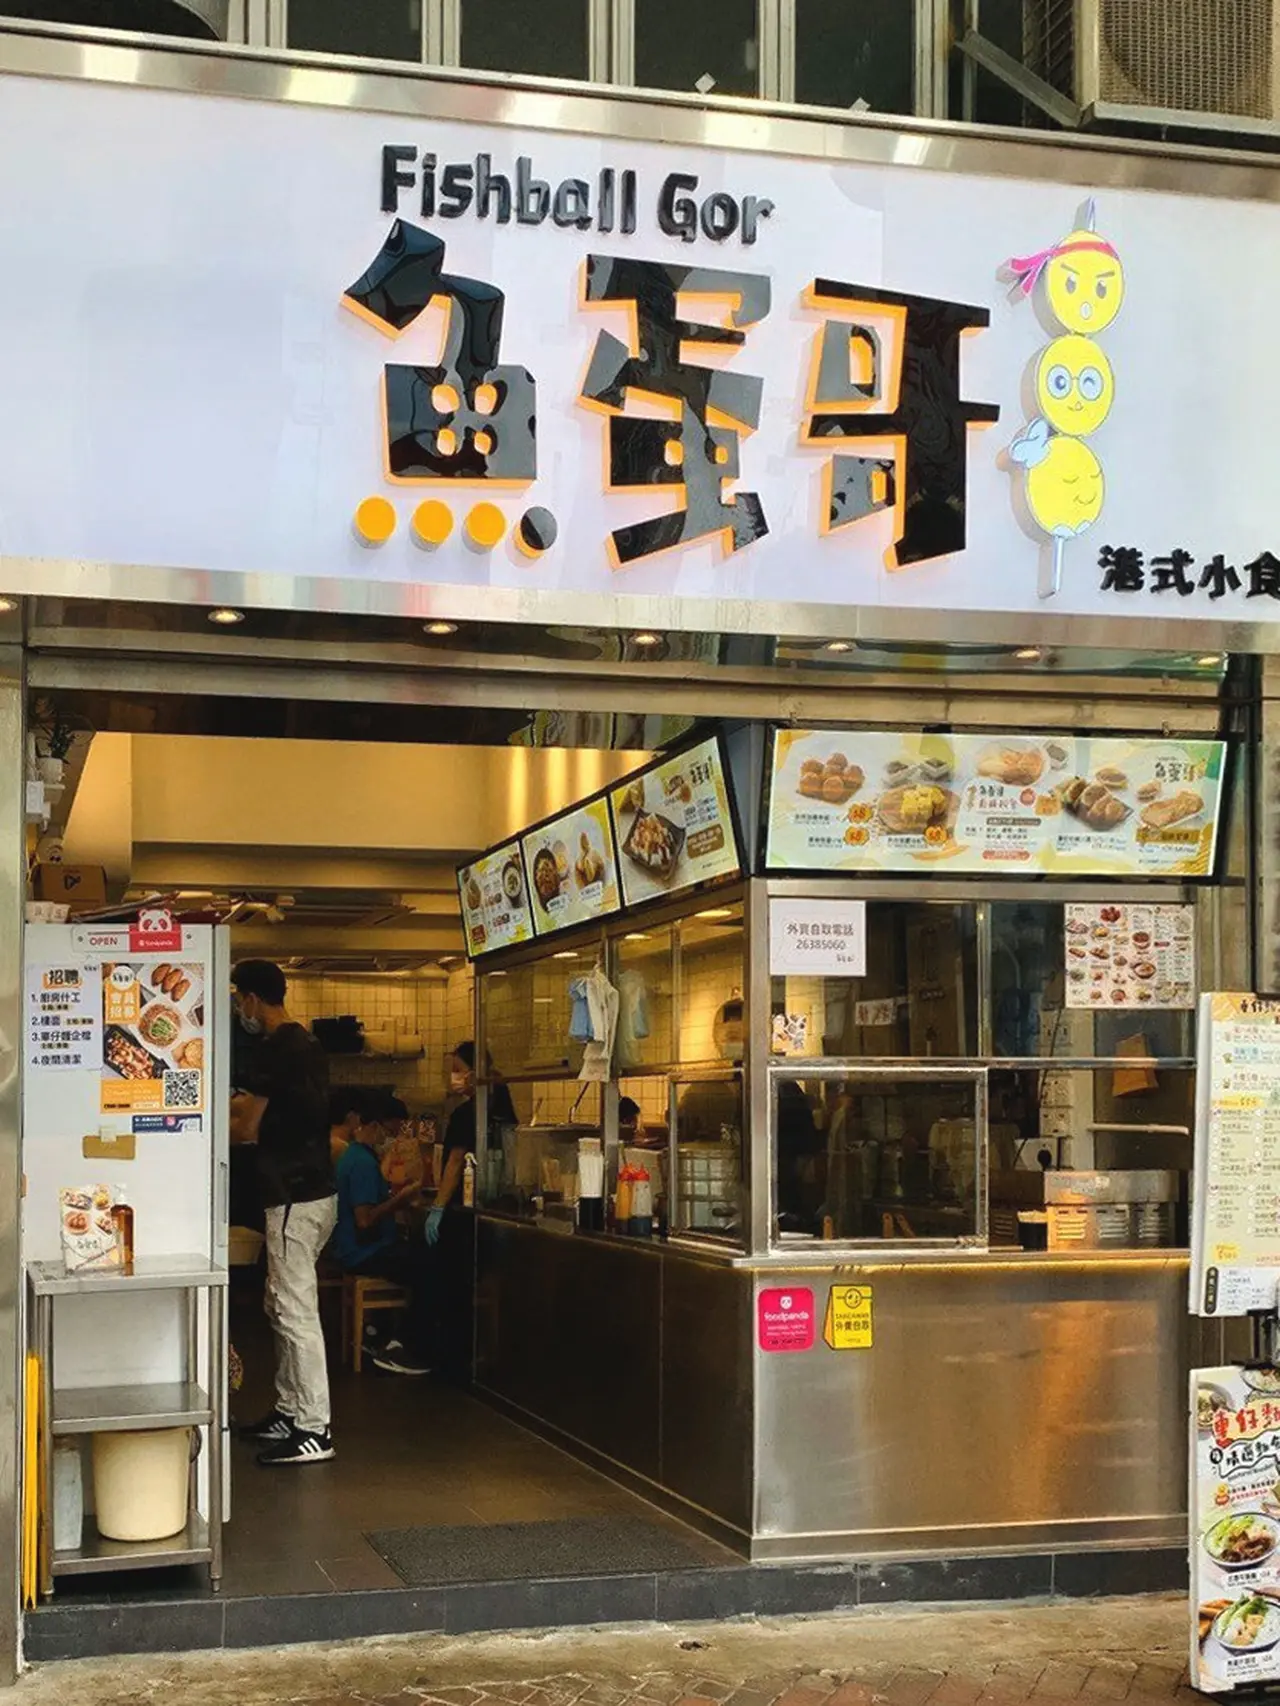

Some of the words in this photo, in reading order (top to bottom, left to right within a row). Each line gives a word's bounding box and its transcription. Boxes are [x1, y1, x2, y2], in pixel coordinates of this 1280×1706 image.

[380, 145, 637, 234] Fishball
[658, 173, 774, 245] Gor
[342, 217, 1000, 570] 魚蛋哥
[1098, 545, 1280, 600] 港式小食
[89, 936, 118, 946] OPEN
[796, 939, 846, 950] 26385060
[49, 968, 79, 985] 招聘
[763, 1310, 810, 1322] foodpanda
